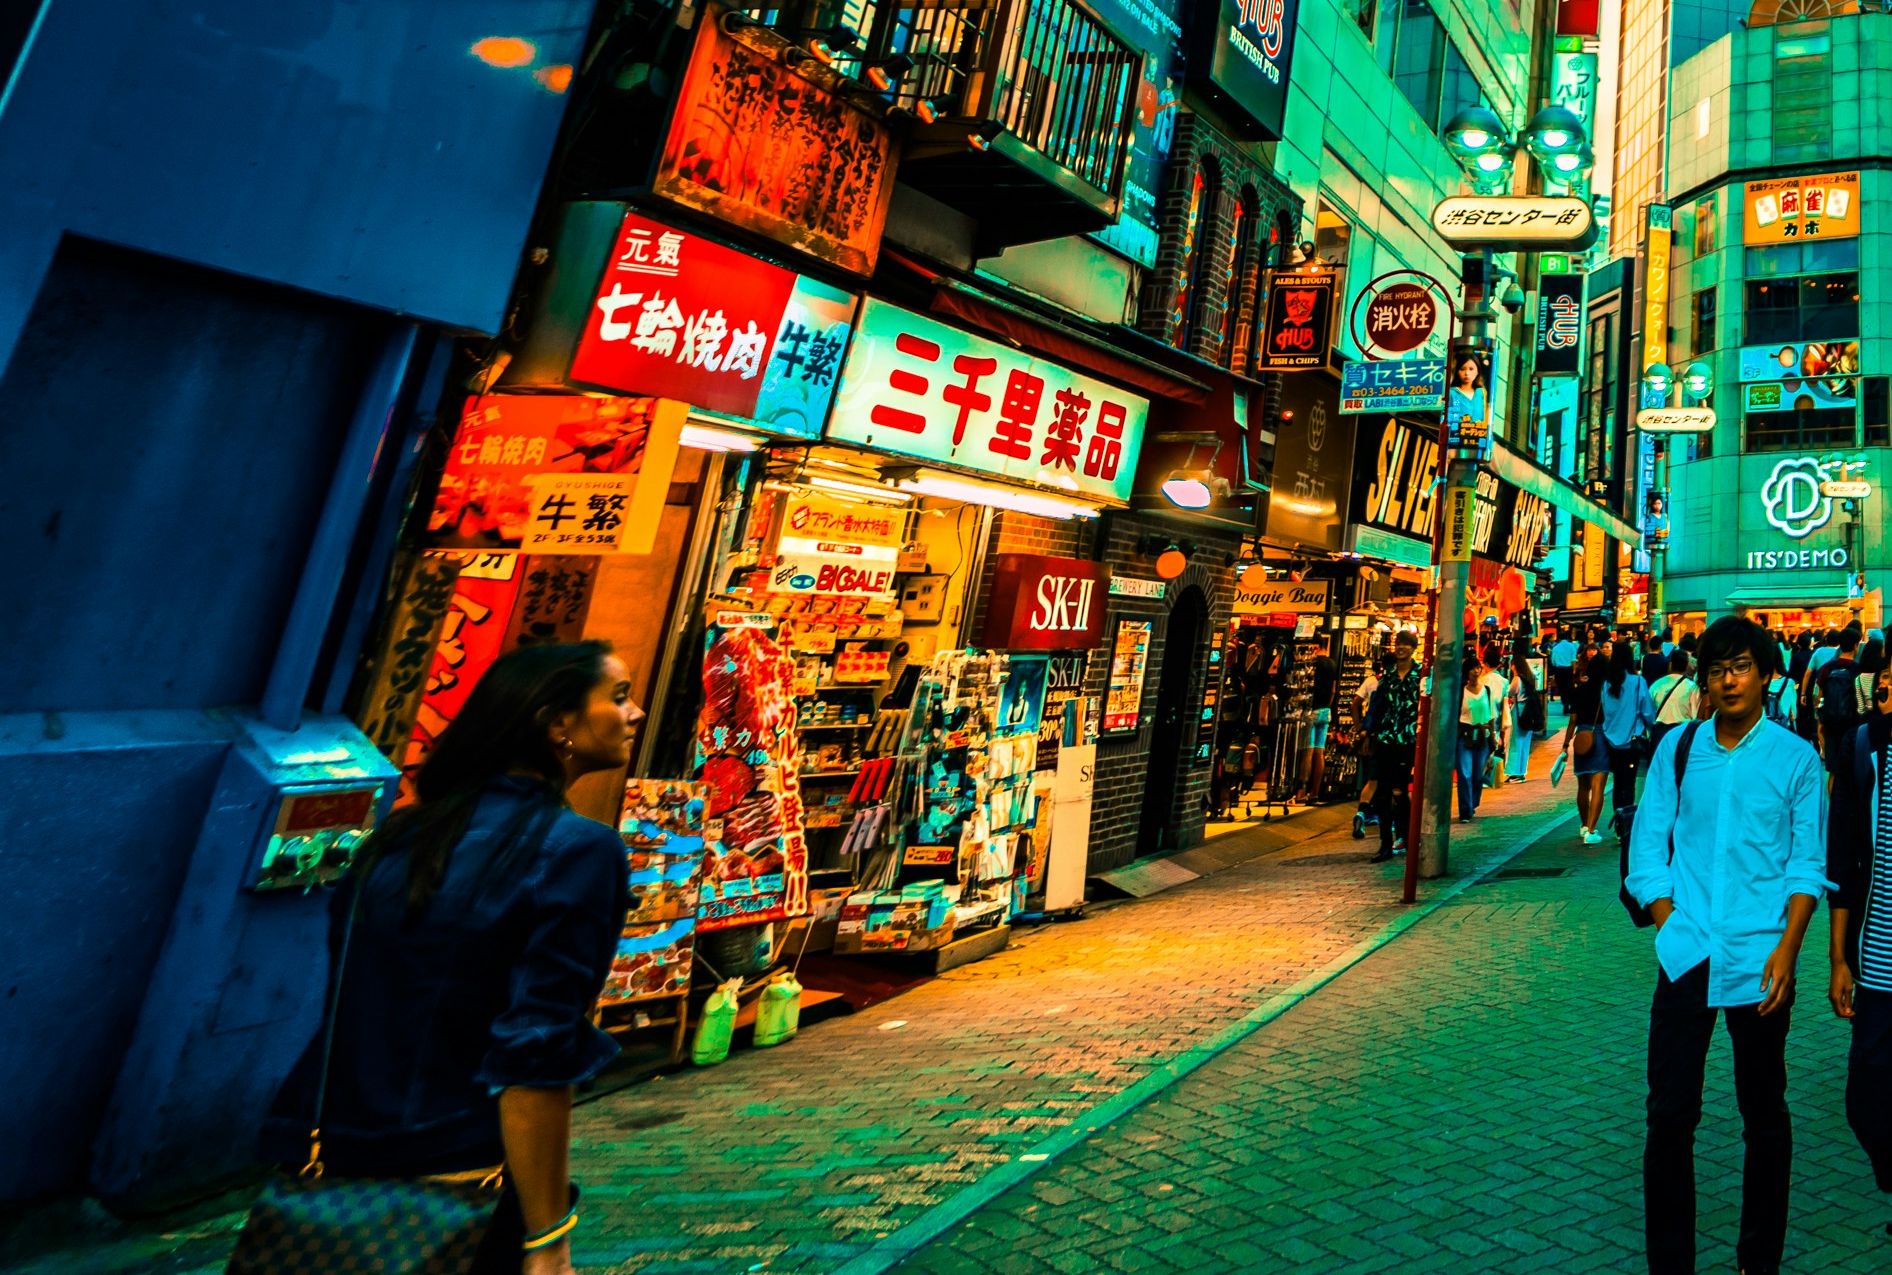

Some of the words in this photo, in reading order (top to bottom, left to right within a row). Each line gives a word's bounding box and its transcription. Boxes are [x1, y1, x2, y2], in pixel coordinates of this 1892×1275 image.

[1229, 24, 1263, 69] BRITISH
[1263, 56, 1281, 85] PUB
[1780, 188, 1823, 213] 麻雀
[1441, 207, 1584, 226] 渋谷センター街
[1378, 292, 1393, 301] FIRE
[1395, 290, 1425, 300] HYDRANT
[1372, 302, 1431, 332] 消火栓
[1548, 293, 1579, 352] HUB
[1275, 326, 1316, 351] HUB
[777, 318, 846, 387] 牛繁
[1269, 357, 1287, 366] FISH
[1296, 356, 1320, 366] CHIPS
[870, 332, 1128, 482] 三千里薬品
[1642, 413, 1711, 426] 渋谷センター街
[555, 481, 626, 490] GYUSHIGE
[536, 493, 629, 532] 牛繁
[1451, 490, 1467, 557] 客引きは犯罪です
[1747, 548, 1848, 570] ITS'DEMO
[1144, 582, 1166, 598] LANE
[1289, 586, 1326, 607] Bag
